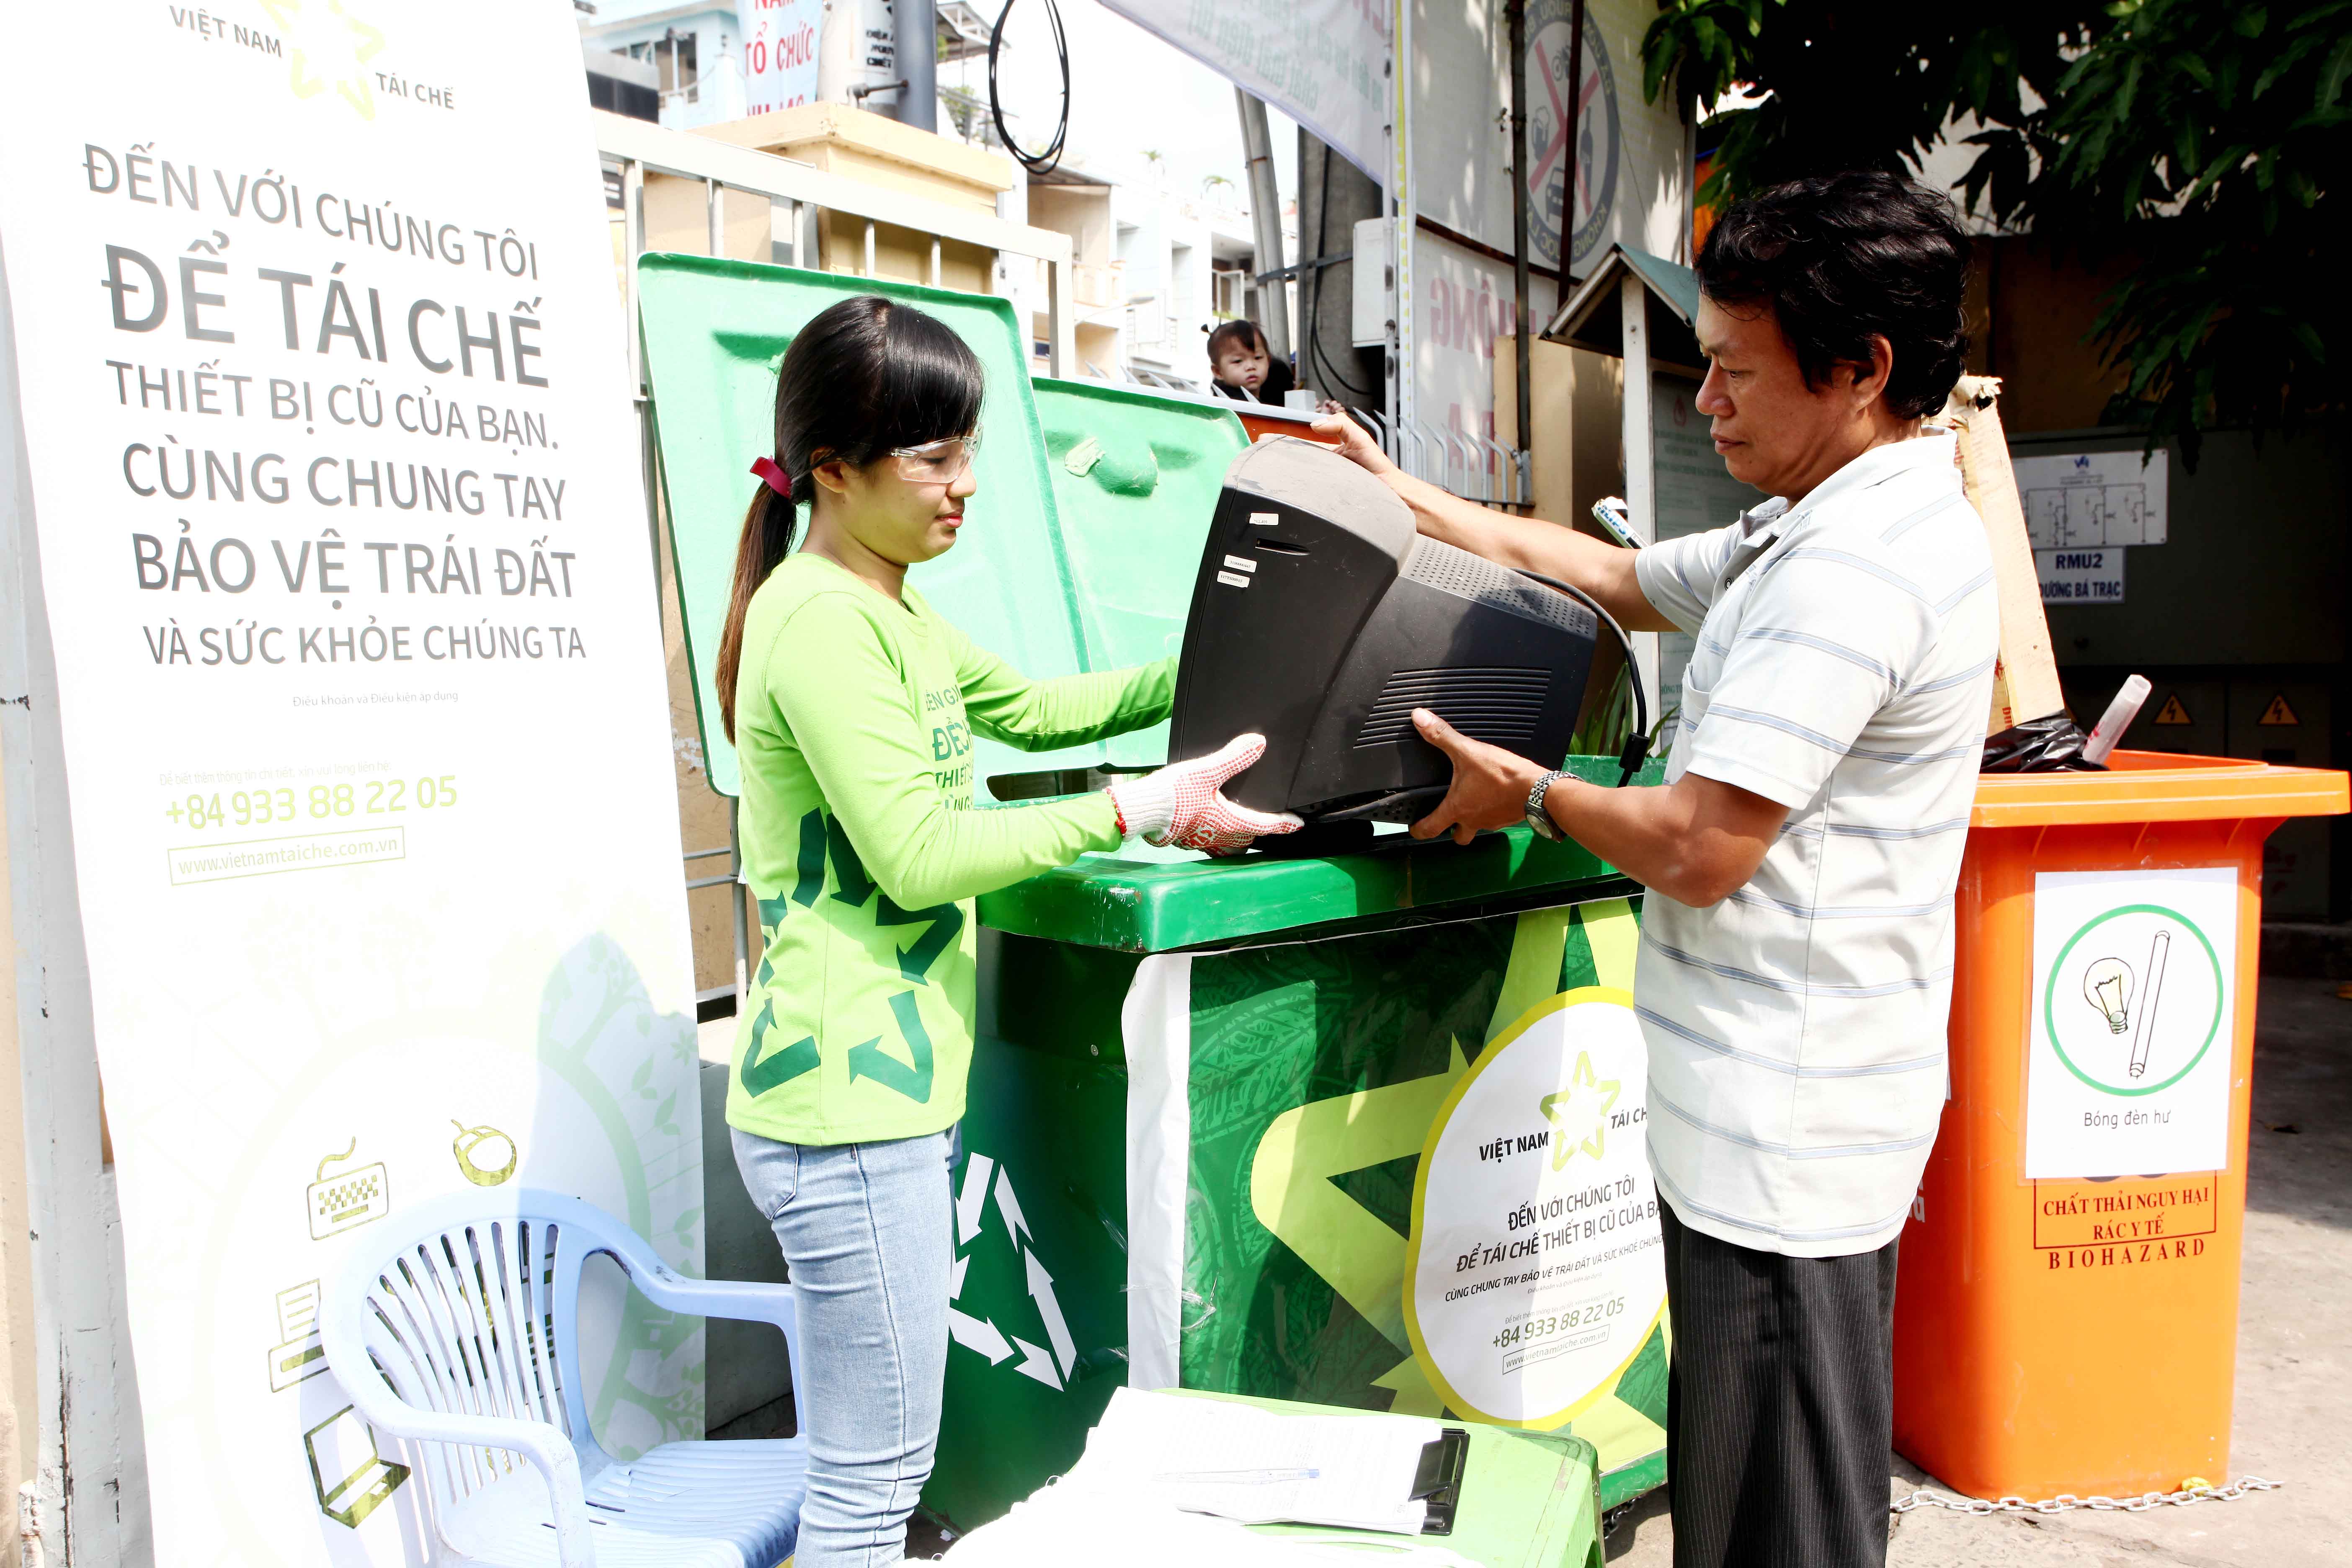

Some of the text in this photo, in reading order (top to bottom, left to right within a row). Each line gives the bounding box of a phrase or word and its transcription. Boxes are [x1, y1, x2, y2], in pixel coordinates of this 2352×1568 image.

[170, 5, 281, 58] VIỆT NAM
[777, 21, 813, 71] CHỨC
[376, 72, 454, 109] TÁI CHẾ
[83, 142, 537, 280] ĐẾN VỚI CHÚNG TÔI
[101, 230, 549, 388] ĐỂ TÁI CHẾ
[106, 359, 558, 456] THIẾT BỊ CŨ CỦA BẠN.
[124, 434, 565, 521] CÙNG CHUNG TAY
[132, 518, 575, 610] BẢO VỆ TRÁI ĐẤT
[2055, 553, 2103, 570] RMU2
[2075, 578, 2089, 598] BÁ
[143, 615, 586, 665] VÀ SỨC KHỎE CHÚNG TA
[165, 775, 457, 830] +84 933 88 22 05
[179, 838, 398, 874] www.vietnamtaiche.com.vn
[1611, 1107, 1647, 1129] TÁI CH
[2084, 1109, 2171, 1129] Bóng đèn hư
[1479, 1131, 1549, 1163] VIỆT NAM
[1509, 1174, 1635, 1230] ĐẾN VỚI CHÚNG TÔI
[2043, 1186, 2209, 1217] CHẤT THẢI NGUY HẠI
[2093, 1212, 2166, 1240] RÁC Y TẾ
[1457, 1200, 1661, 1272] ĐỂ TÁI CHẾ THIẾT BỊ CŨ CỦA BẠ
[1445, 1286, 1469, 1302] CÙNG
[1471, 1279, 1500, 1295] CHUNG
[1504, 1275, 1519, 1286] TAY
[1521, 1270, 1539, 1283] BẢO
[1542, 1265, 1553, 1279] VỆ
[1555, 1262, 1573, 1276] TRÁI
[1575, 1253, 1591, 1270] ĐẤT
[1593, 1249, 1602, 1263] VÀ
[1604, 1246, 1618, 1262] SỨC
[1493, 1296, 1625, 1348] +84 933 88 22 05
[1506, 1330, 1606, 1368] www.vietnamtaiche.com.vn
